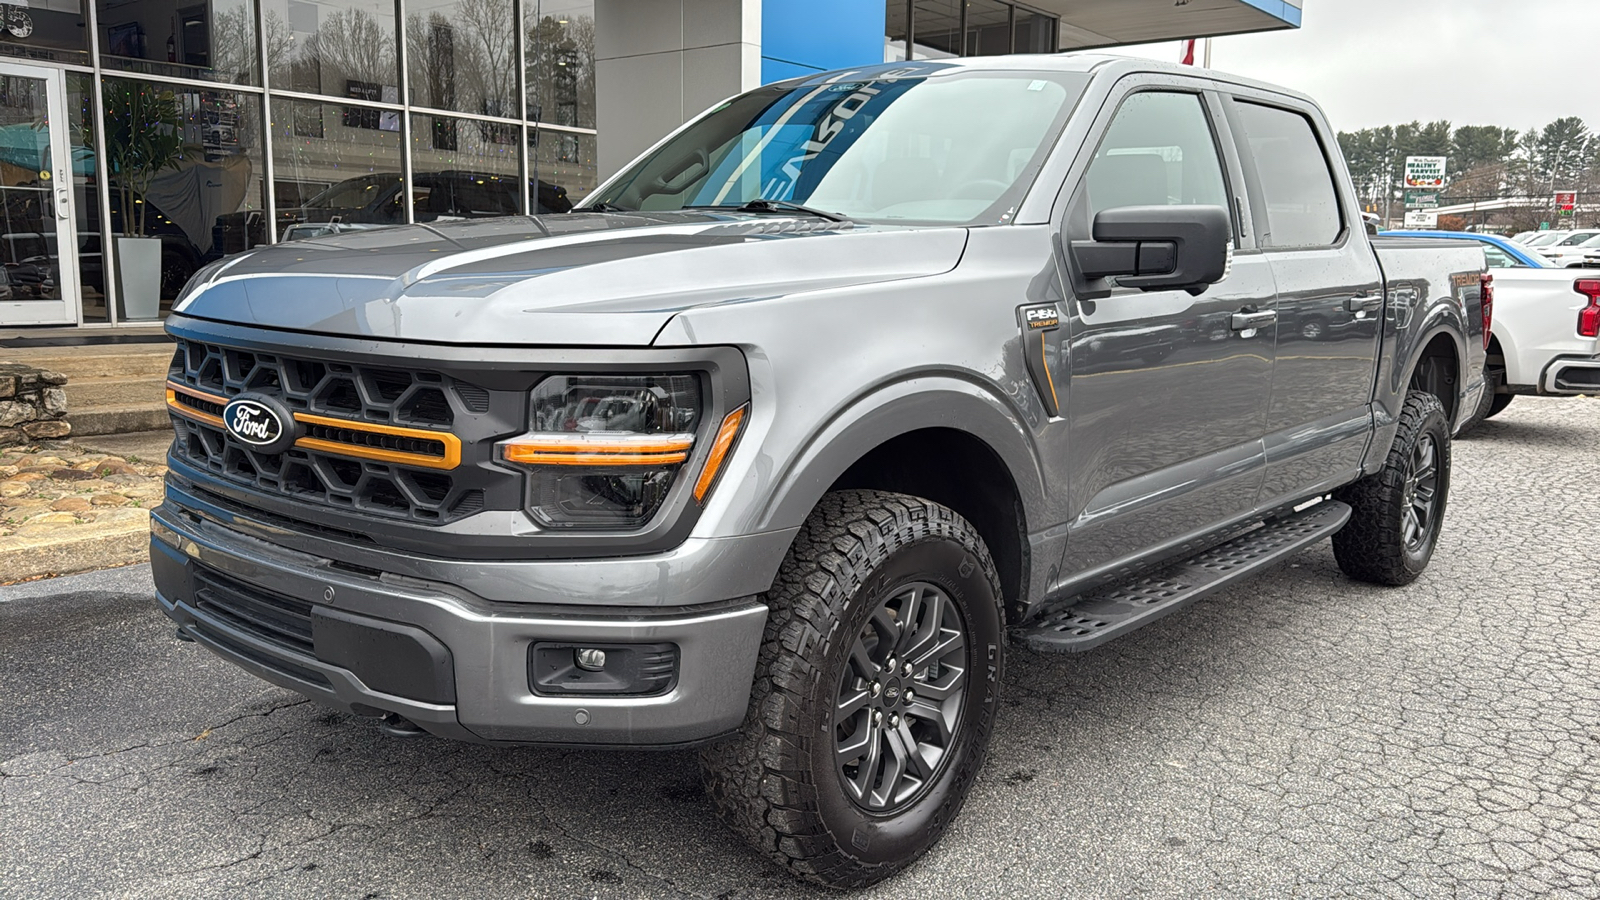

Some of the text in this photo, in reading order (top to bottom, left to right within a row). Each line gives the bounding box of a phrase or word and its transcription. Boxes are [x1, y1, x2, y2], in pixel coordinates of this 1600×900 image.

[0, 4, 33, 38] 5
[1452, 273, 1480, 287] TREMOR
[1026, 308, 1058, 321] F-150
[1030, 320, 1057, 328] TREMOR
[232, 404, 271, 440] Ford
